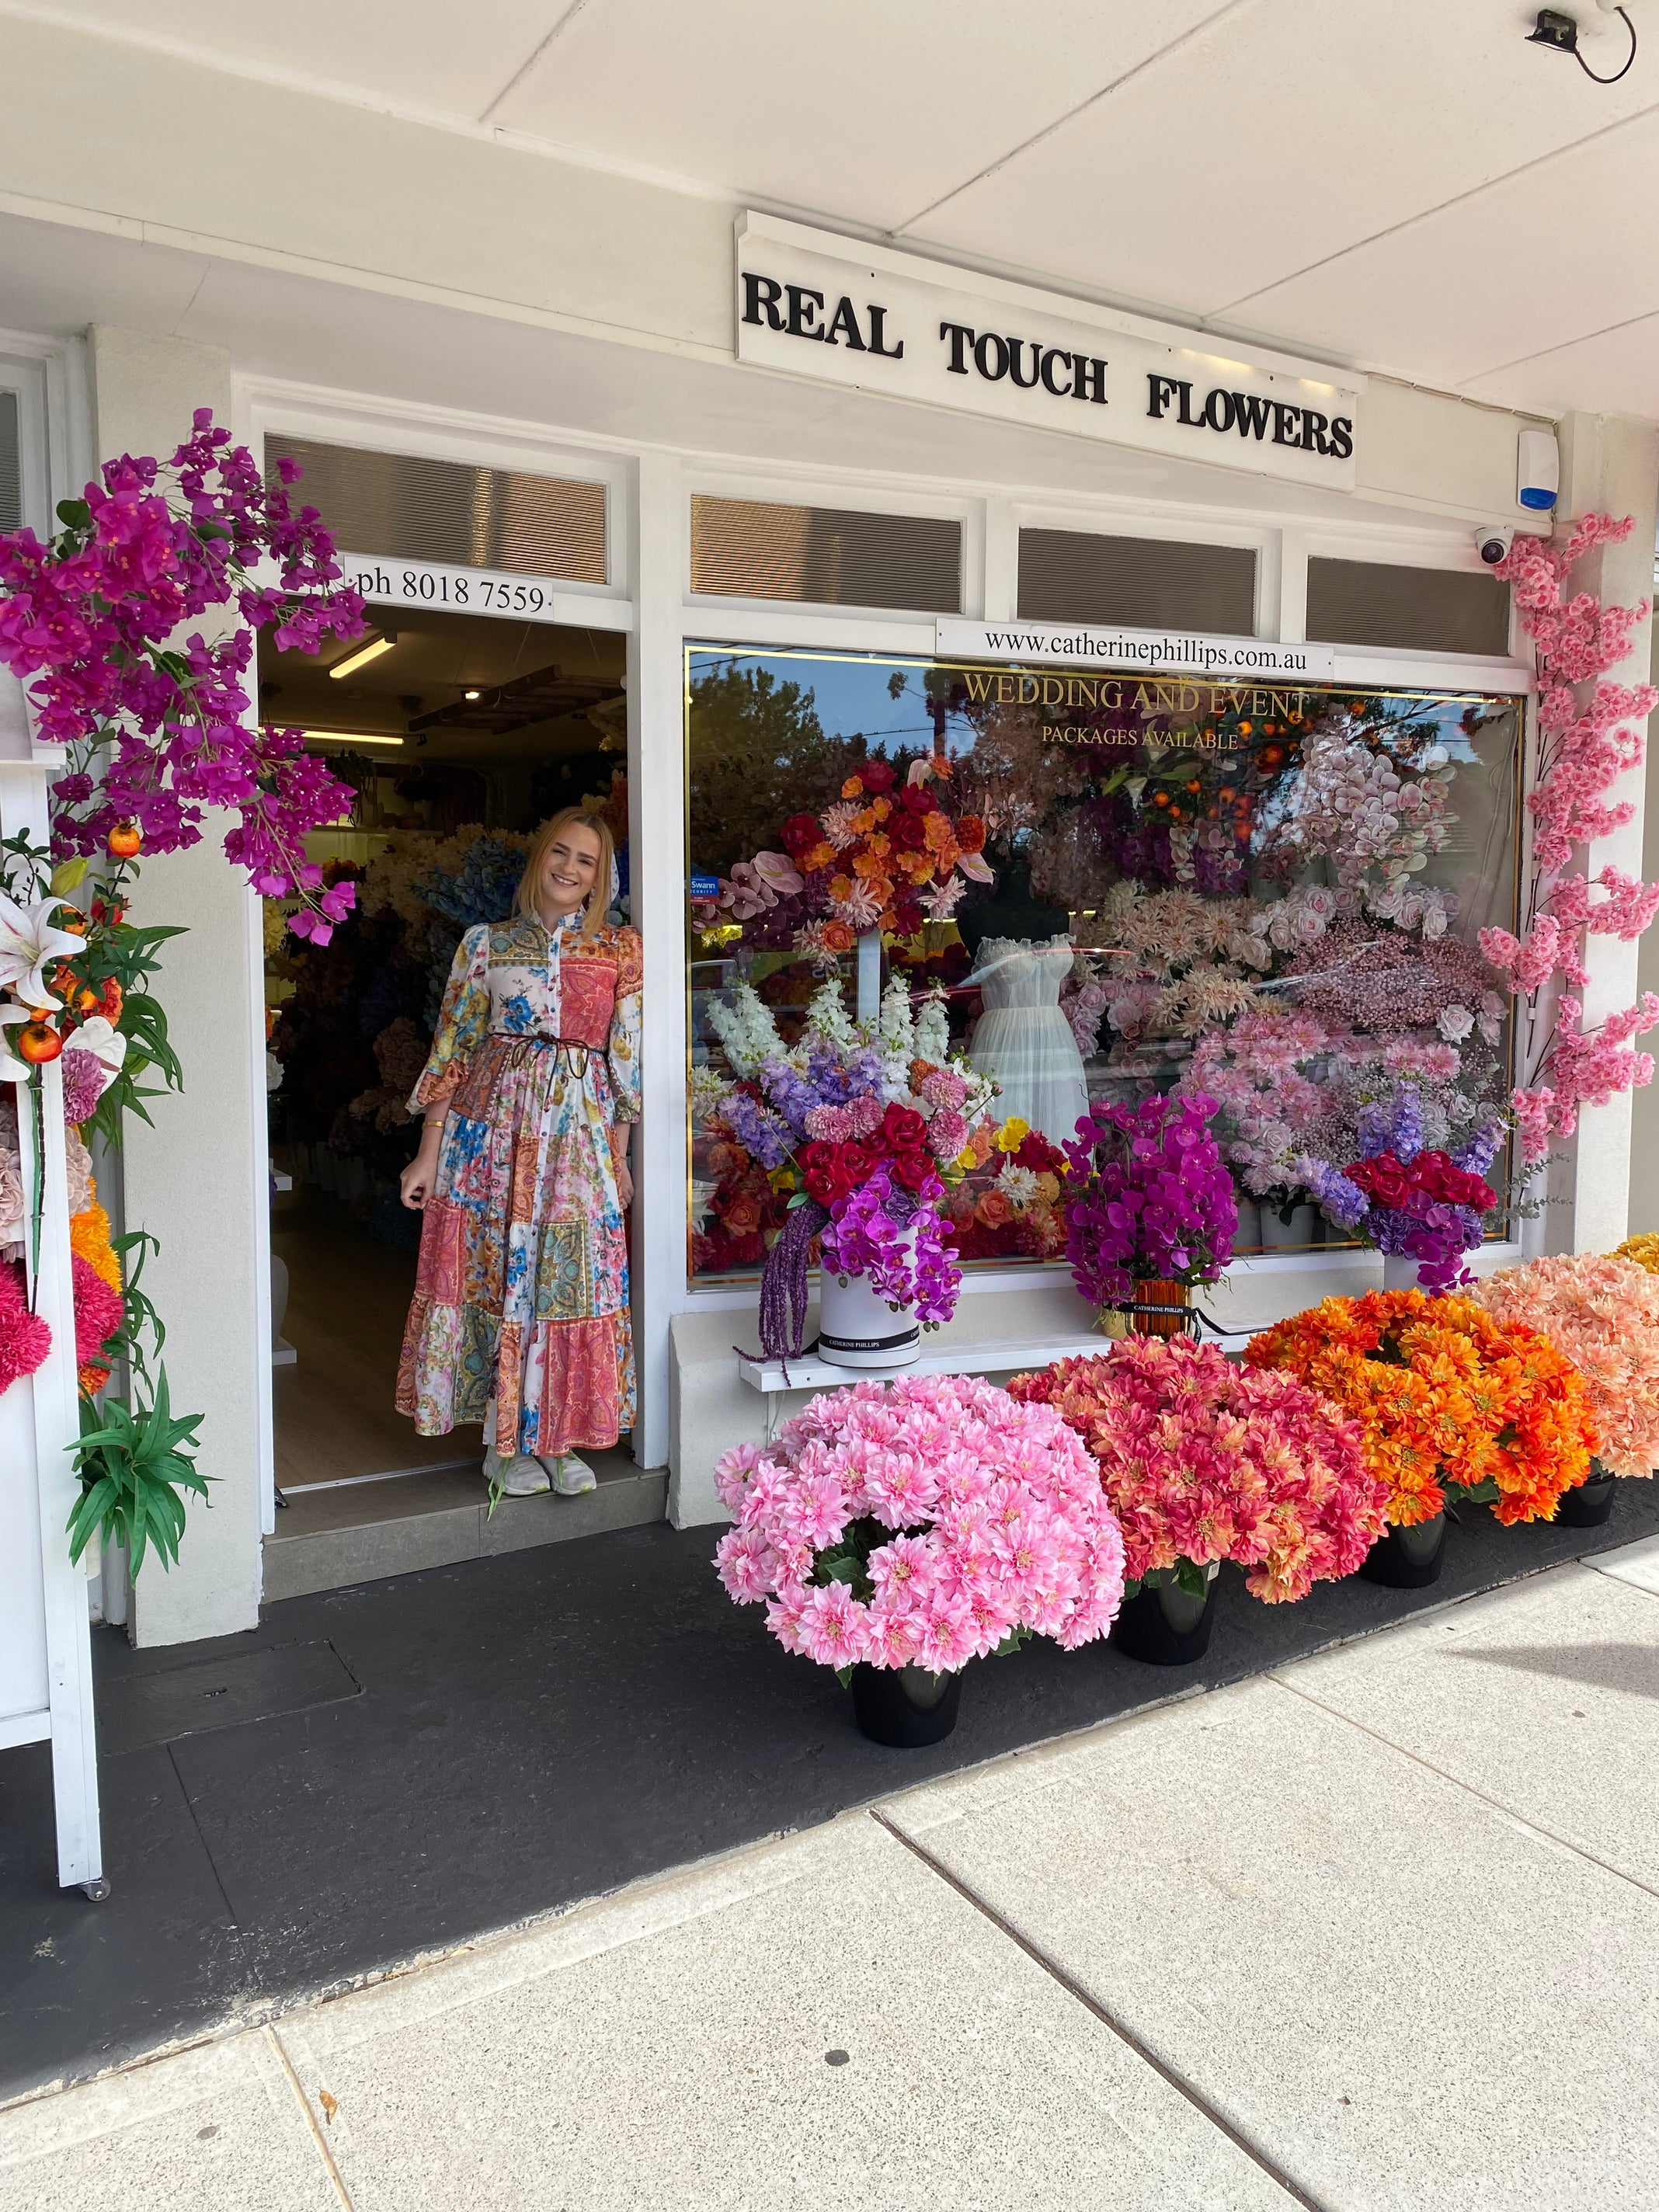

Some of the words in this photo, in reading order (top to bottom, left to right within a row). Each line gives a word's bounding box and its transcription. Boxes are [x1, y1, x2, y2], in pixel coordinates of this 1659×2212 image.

[741, 272, 903, 358] REAL
[940, 322, 1108, 404] TOUCH
[1147, 374, 1353, 459] FLOWERS
[356, 567, 392, 595] ph
[402, 571, 469, 603] 8018
[479, 581, 544, 612] 7559
[985, 632, 1307, 670] www.catherinephillips.com.au
[963, 673, 1123, 708] WEDDING
[1130, 682, 1199, 713] AND
[1209, 687, 1310, 719] EVENT
[1042, 726, 1137, 746] PACKAGES
[1141, 731, 1239, 750] AVAILABLE
[829, 1339, 855, 1348] CATHERINE
